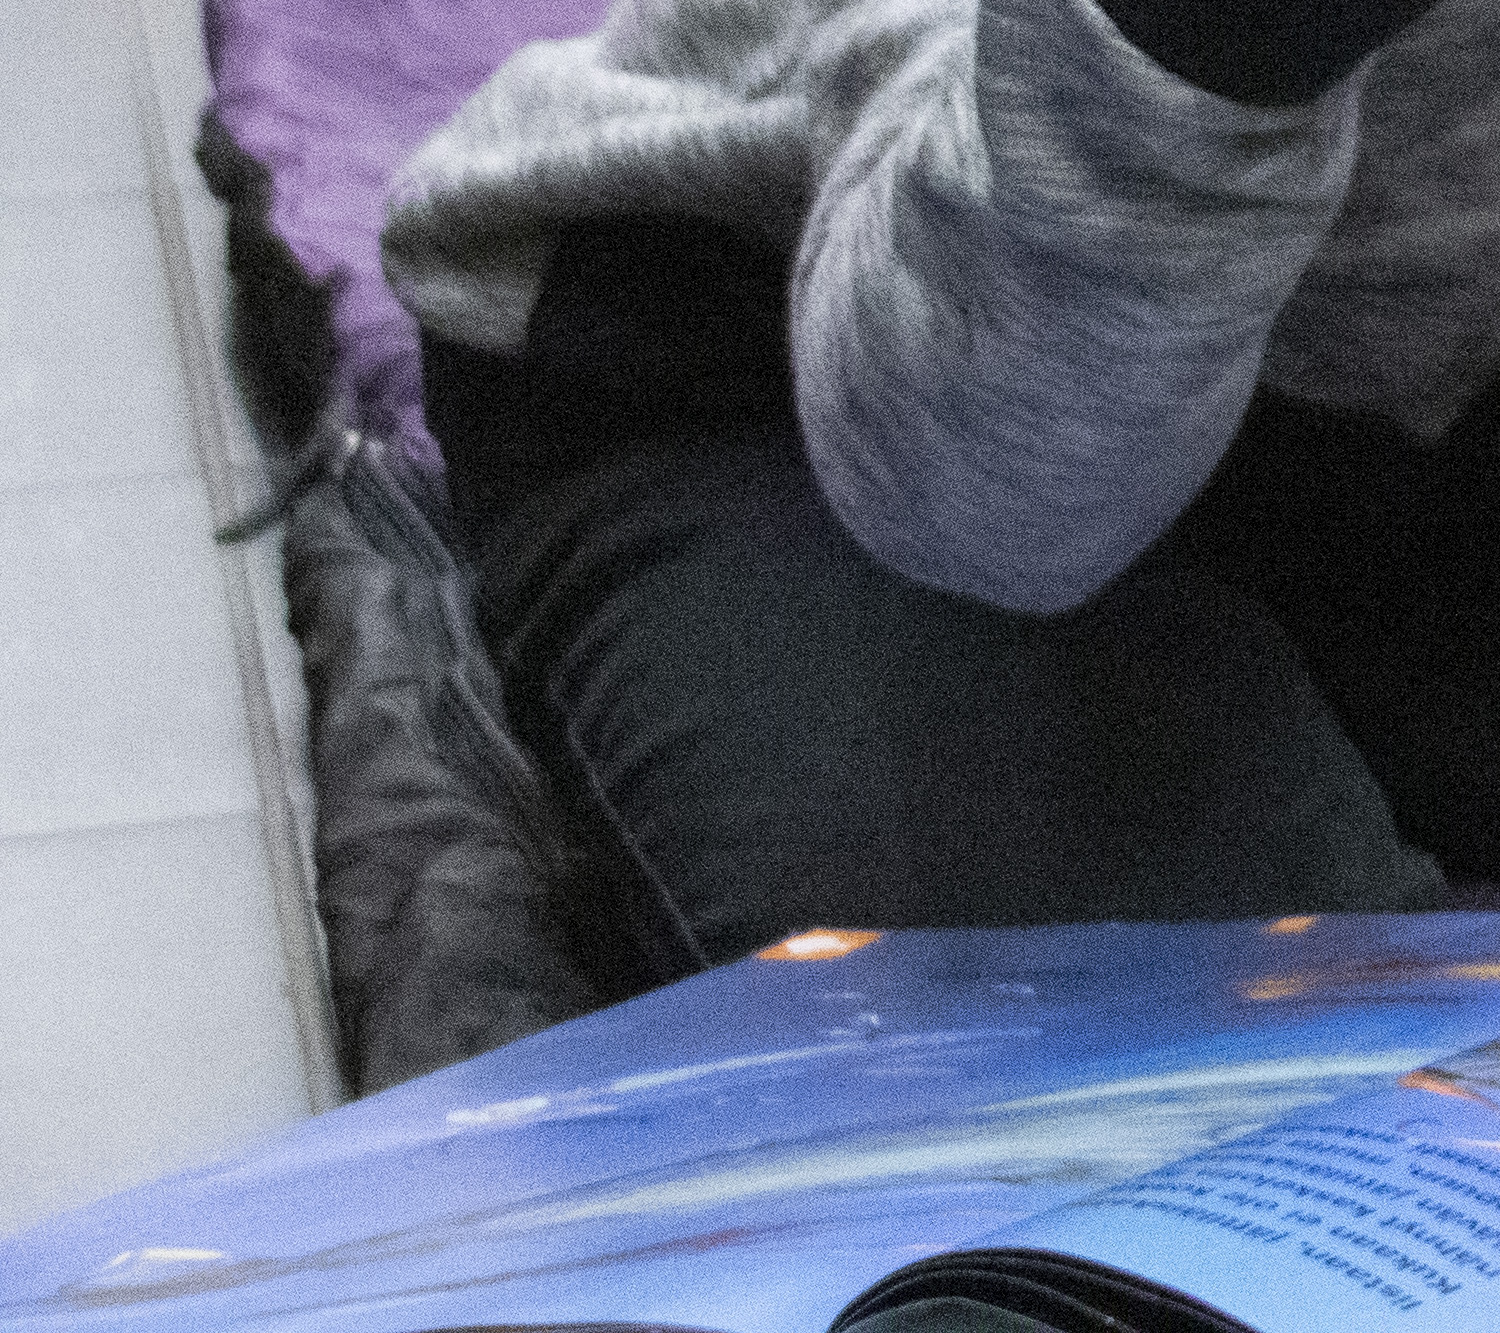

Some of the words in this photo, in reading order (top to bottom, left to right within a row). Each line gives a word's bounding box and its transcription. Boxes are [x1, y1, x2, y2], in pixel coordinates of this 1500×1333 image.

[1300, 1241, 1422, 1311] listaan,
[1331, 1226, 1461, 1296] Kukaan
[1379, 1217, 1500, 1278] nähnyt
